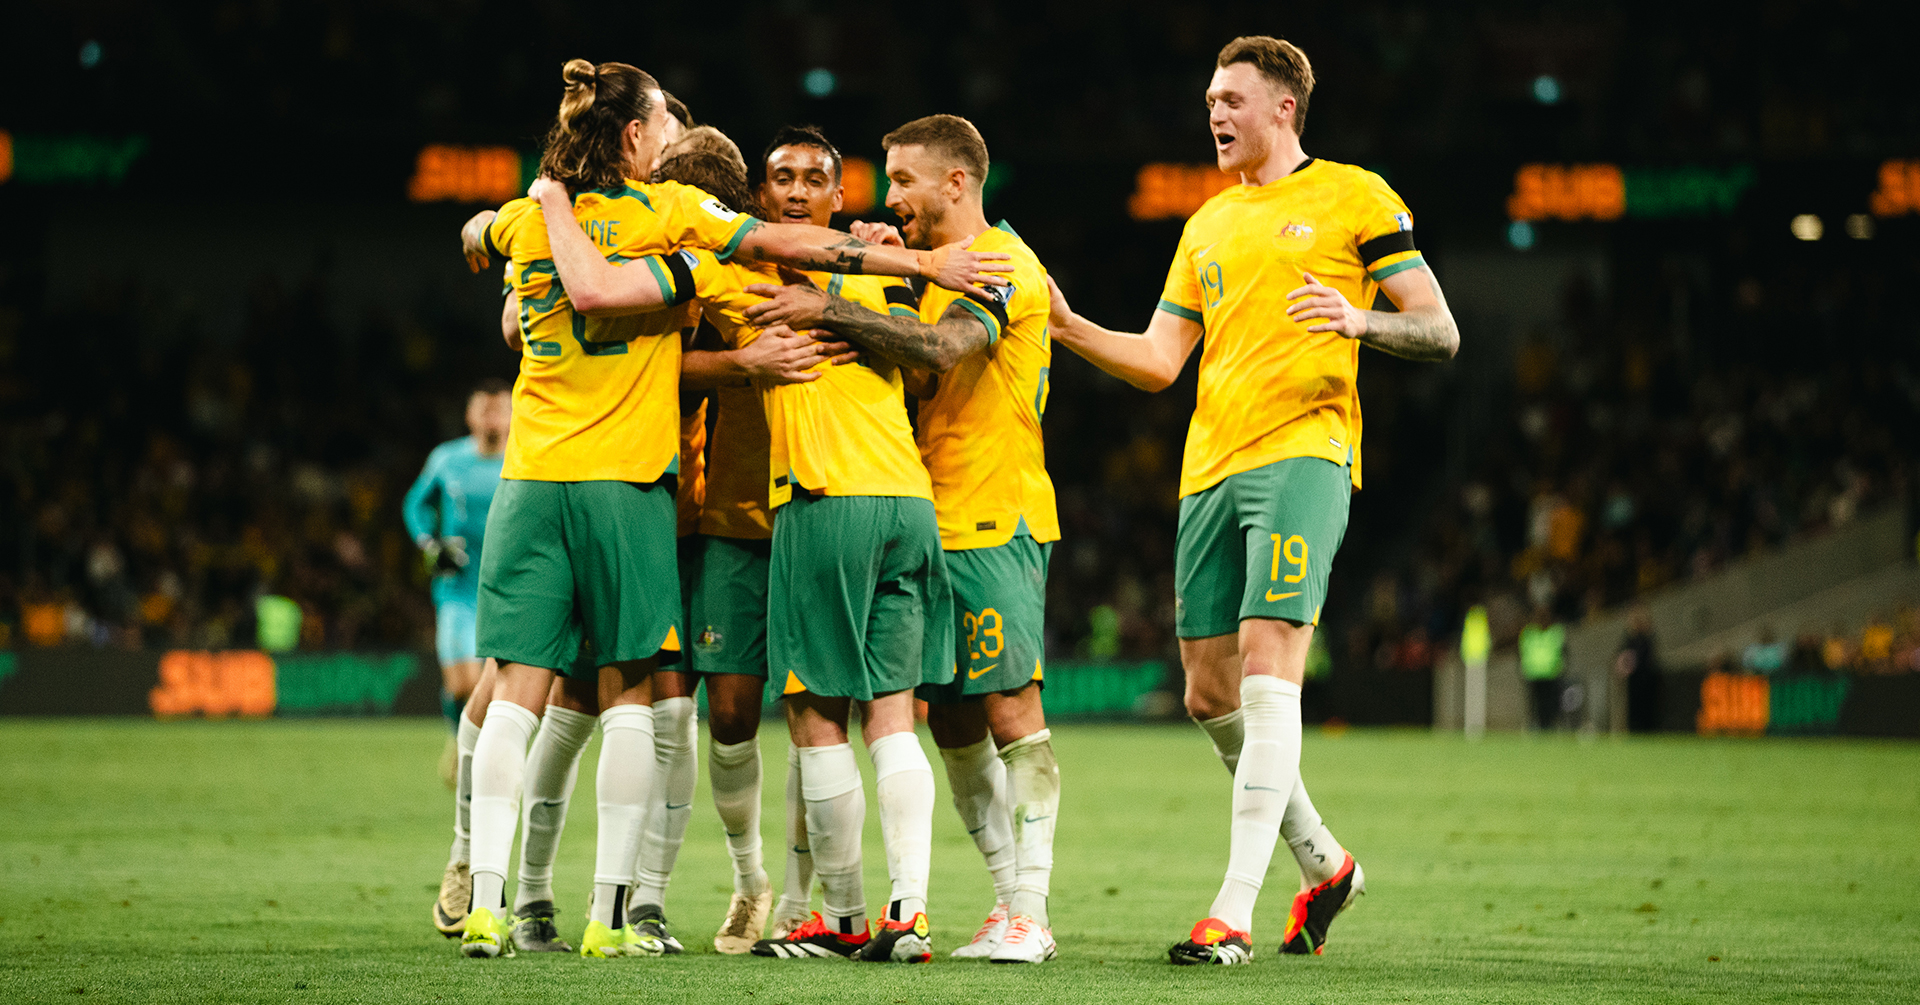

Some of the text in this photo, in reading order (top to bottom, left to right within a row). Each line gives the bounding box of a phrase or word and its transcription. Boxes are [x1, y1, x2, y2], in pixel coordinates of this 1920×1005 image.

[579, 219, 620, 247] INE
[1199, 261, 1224, 310] 19
[1270, 533, 1308, 583] 19
[963, 608, 1004, 658] 23
